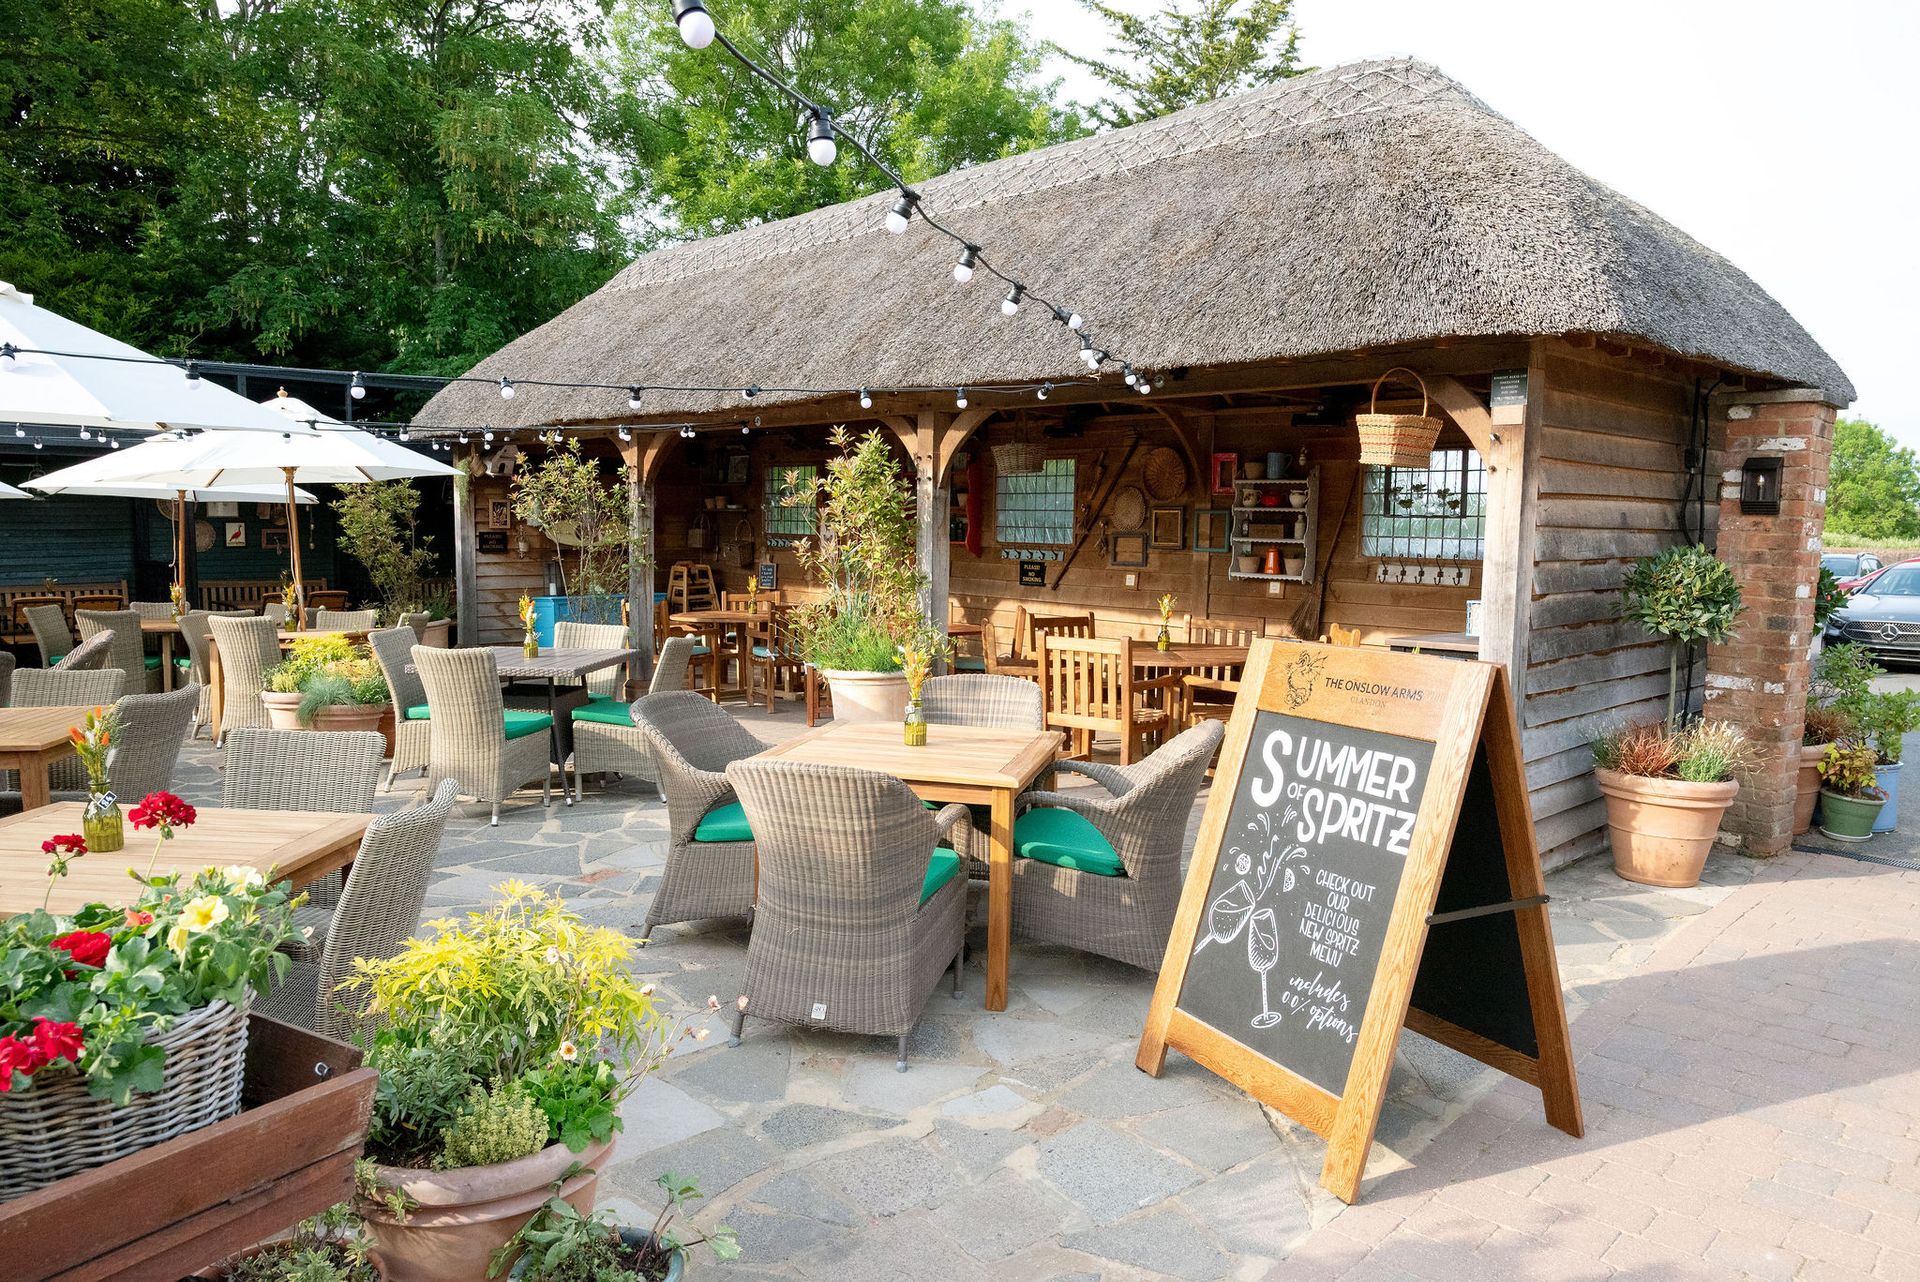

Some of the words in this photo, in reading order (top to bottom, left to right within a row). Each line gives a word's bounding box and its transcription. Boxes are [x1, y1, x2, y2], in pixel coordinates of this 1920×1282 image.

[1325, 677, 1344, 690] THE
[1345, 680, 1391, 697] ONSLOW
[1391, 687, 1424, 701] ARMS
[1251, 729, 1417, 808] SUMMER
[1287, 782, 1307, 800] OF
[1297, 788, 1417, 856] SPRITZ
[1315, 869, 1351, 893] CHECK
[1350, 880, 1376, 902] OUT
[1327, 891, 1350, 913] OUR
[1299, 917, 1325, 942] NEW
[1325, 928, 1360, 956] SPRITZ
[1304, 901, 1360, 937] DELICIOUS
[1309, 941, 1343, 968] MENU
[1289, 971, 1351, 1012] includes
[1282, 991, 1312, 1016] 0.0%
[1306, 1005, 1359, 1043] options
